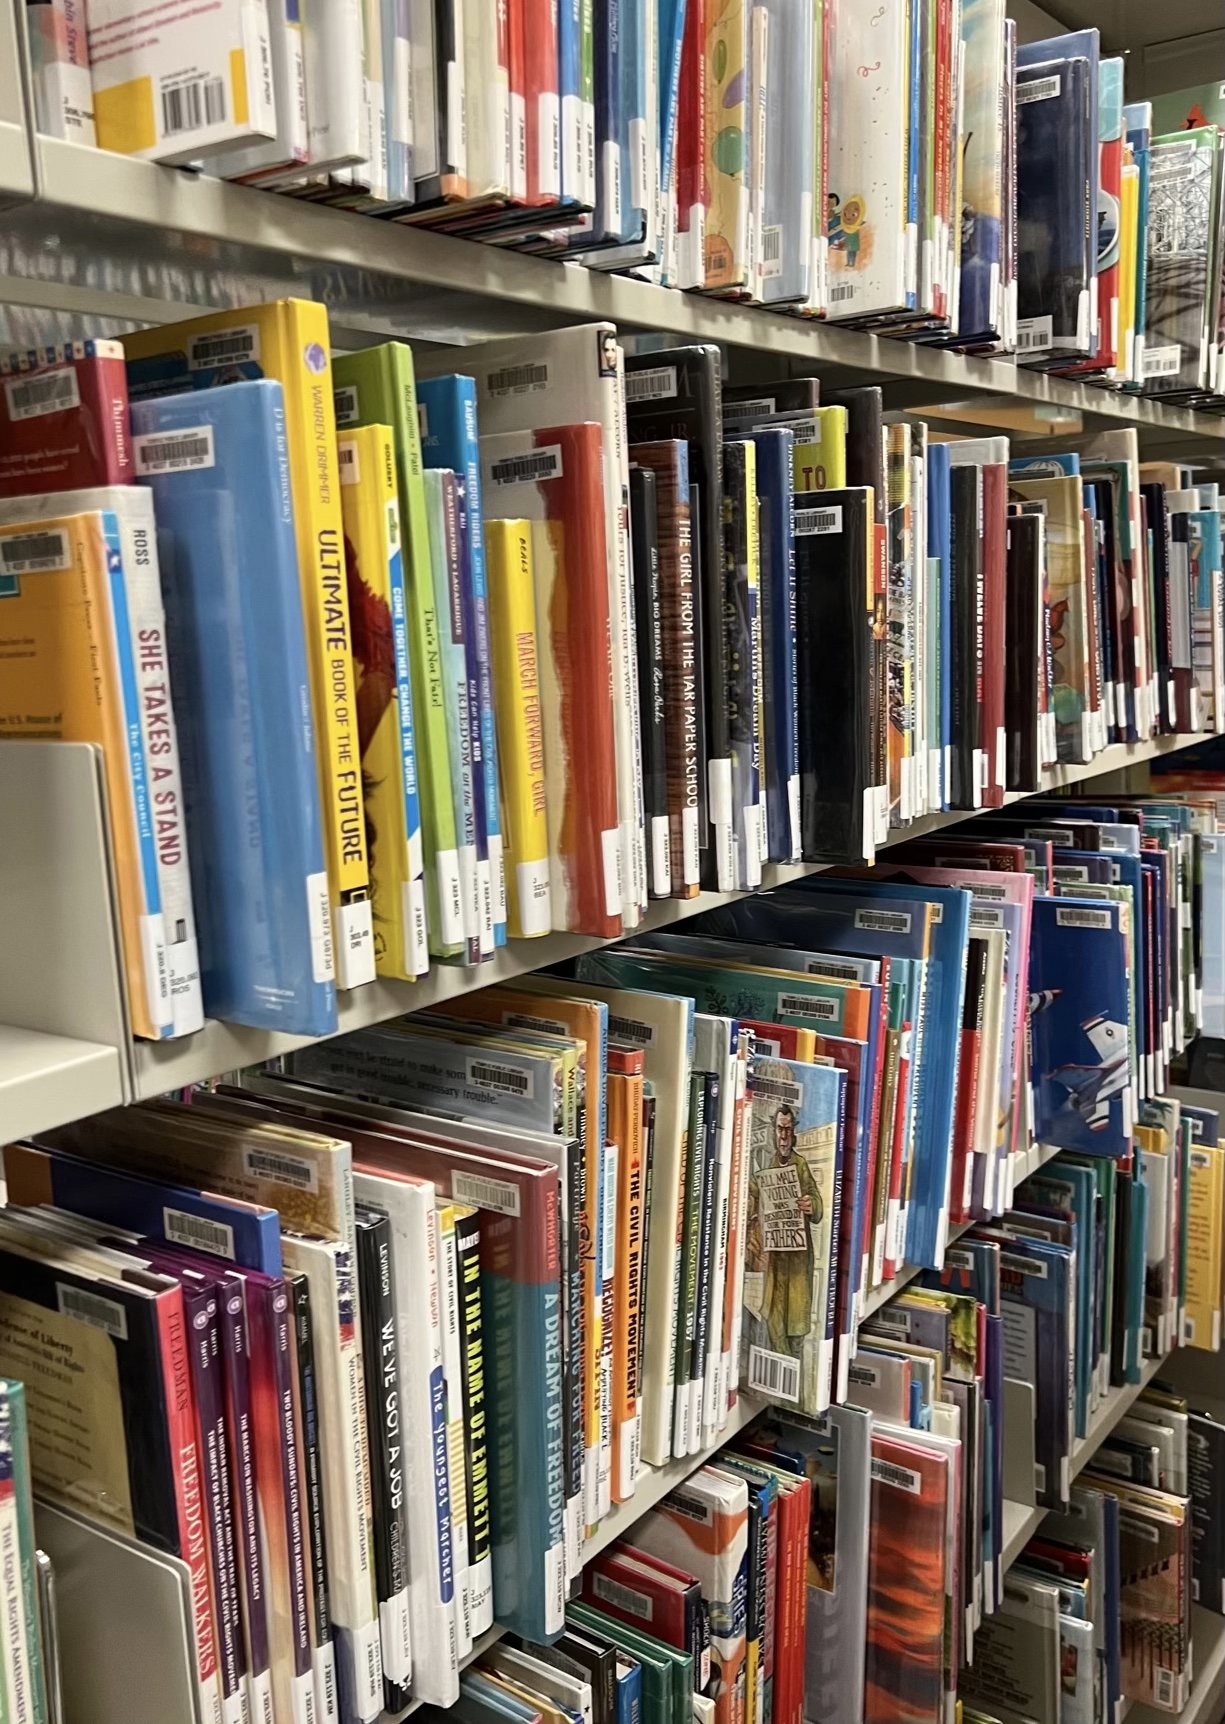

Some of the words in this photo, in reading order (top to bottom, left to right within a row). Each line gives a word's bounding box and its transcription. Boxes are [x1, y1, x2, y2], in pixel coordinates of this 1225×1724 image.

[671, 39, 682, 89] BROTHERS
[310, 385, 326, 440] WARREN
[403, 384, 415, 438] McLaughlin
[410, 451, 419, 475] Patel
[464, 399, 473, 439] BAUSUM
[111, 398, 130, 466] Thimmesh
[277, 455, 293, 525] Democracy
[316, 444, 330, 503] DRIMMER
[468, 461, 478, 508] FREEDOM
[802, 466, 827, 491] TO
[446, 485, 457, 560] WEATHERFORD
[471, 512, 480, 548] RIDERS
[677, 519, 690, 546] THE
[131, 528, 150, 566] ROSS
[517, 536, 529, 573] BEALS
[678, 553, 691, 585] GIRL
[318, 528, 345, 651] ULTIMATE
[392, 587, 403, 618] COME
[423, 608, 436, 645] That's
[680, 592, 693, 633] FROM
[138, 628, 163, 672] SHE
[653, 621, 661, 659] DREAMS
[681, 641, 694, 666] THE
[750, 617, 758, 679] Martin's
[427, 648, 438, 673] Not
[516, 631, 537, 689] MARCH
[331, 658, 346, 702] BOOK
[429, 677, 441, 707] Fair!
[652, 667, 662, 692] Rosa
[682, 675, 695, 699] TAR
[143, 682, 171, 755] TAKES
[335, 707, 348, 726] OF
[398, 683, 411, 729] CHANGE
[456, 681, 469, 767] FREEDOM
[653, 695, 664, 724] Parks
[129, 723, 140, 746] The
[336, 732, 351, 763] THE
[402, 731, 412, 753] THE
[520, 695, 544, 776] FORWARD,
[683, 706, 696, 751] PAPER
[130, 752, 143, 779] City
[473, 741, 481, 761] KIDS
[151, 765, 173, 781] A
[404, 755, 415, 794] WORLD
[135, 784, 150, 837] Council
[336, 770, 362, 865] FUTURE
[531, 780, 547, 817] GIRL
[154, 790, 181, 867] STAND
[417, 1080, 459, 1097] necessary
[419, 1063, 443, 1076] make
[564, 1067, 577, 1112] Wallace
[566, 1116, 575, 1136] and
[695, 1090, 704, 1139] EXPLORING
[693, 1141, 701, 1162] CIVIL
[572, 1161, 581, 1230] Partridge
[630, 1170, 639, 1200] THE
[692, 1164, 700, 1196] RIGHTS
[706, 1158, 714, 1205] Nonviolent
[764, 1185, 798, 1202] VOTING
[776, 1170, 798, 1185] MALE
[833, 1169, 841, 1217] ELIZABETH
[426, 1209, 436, 1261] Levinson
[546, 1191, 554, 1269] McWHORTER
[629, 1206, 638, 1247] CIVIL
[690, 1210, 698, 1232] THE
[703, 1208, 711, 1254] Resistance
[719, 1198, 728, 1248] BIRMINGHAM
[765, 1228, 806, 1248] FATHERS
[378, 1242, 391, 1295] LEVINSON
[463, 1254, 479, 1283] IN
[628, 1252, 638, 1308] RIGHTS
[430, 1283, 439, 1327] Newton
[465, 1287, 482, 1335] THE
[544, 1294, 556, 1308] A
[602, 1278, 612, 1357] RECOGNIZE!
[827, 1287, 835, 1324] TROUBLE
[208, 1328, 219, 1355] Harris
[232, 1325, 243, 1352] Harris
[277, 1324, 289, 1350] Harris
[571, 1272, 580, 1374] MARCHING
[41, 1332, 73, 1357] Liberty
[170, 1311, 185, 1411] FREEDMAN
[199, 1340, 210, 1367] Harris
[380, 1317, 396, 1387] WE'VE
[544, 1313, 560, 1397] DREAM
[626, 1313, 637, 1398] MOVEMENT
[347, 1357, 357, 1399] WOMEN
[466, 1338, 484, 1407] NAME
[283, 1389, 291, 1409] TWO
[350, 1403, 358, 1414] IN
[385, 1390, 399, 1439] GOT
[433, 1382, 443, 1412] The
[546, 1403, 561, 1429] OF
[572, 1383, 580, 1421] FOR
[207, 1429, 215, 1446] THE
[240, 1413, 248, 1430] THE
[351, 1419, 359, 1438] THE
[470, 1410, 485, 1439] OF
[208, 1448, 218, 1479] IMPACT
[217, 1435, 225, 1465] INDIAN
[241, 1431, 250, 1461] MARCH
[353, 1441, 361, 1470] CIVIL
[388, 1445, 400, 1462] A
[434, 1423, 448, 1506] Youngest
[178, 1443, 205, 1560] FREEDOM
[220, 1466, 229, 1506] REMOVAL
[290, 1489, 298, 1511] CIVIL
[355, 1472, 363, 1510] RIGHTS
[389, 1467, 403, 1509] JOB
[471, 1445, 488, 1541] EMMETT
[546, 1438, 563, 1545] FREEDOM
[213, 1494, 221, 1522] BLACK
[292, 1512, 300, 1542] RIGHTS
[1, 1523, 13, 1549] THE
[357, 1513, 366, 1570] MOVEMENT
[385, 1522, 404, 1579] CHILDREN'S
[439, 1518, 450, 1583] Marcher
[2, 1551, 16, 1594] EQUAL
[294, 1555, 303, 1592] AMERICA
[7, 1595, 20, 1643] RIGHTS
[191, 1562, 214, 1673] WALKERS
[296, 1593, 305, 1611] AND
[731, 1574, 747, 1633] SPIES
[12, 1646, 26, 1724] AMENDMENT
